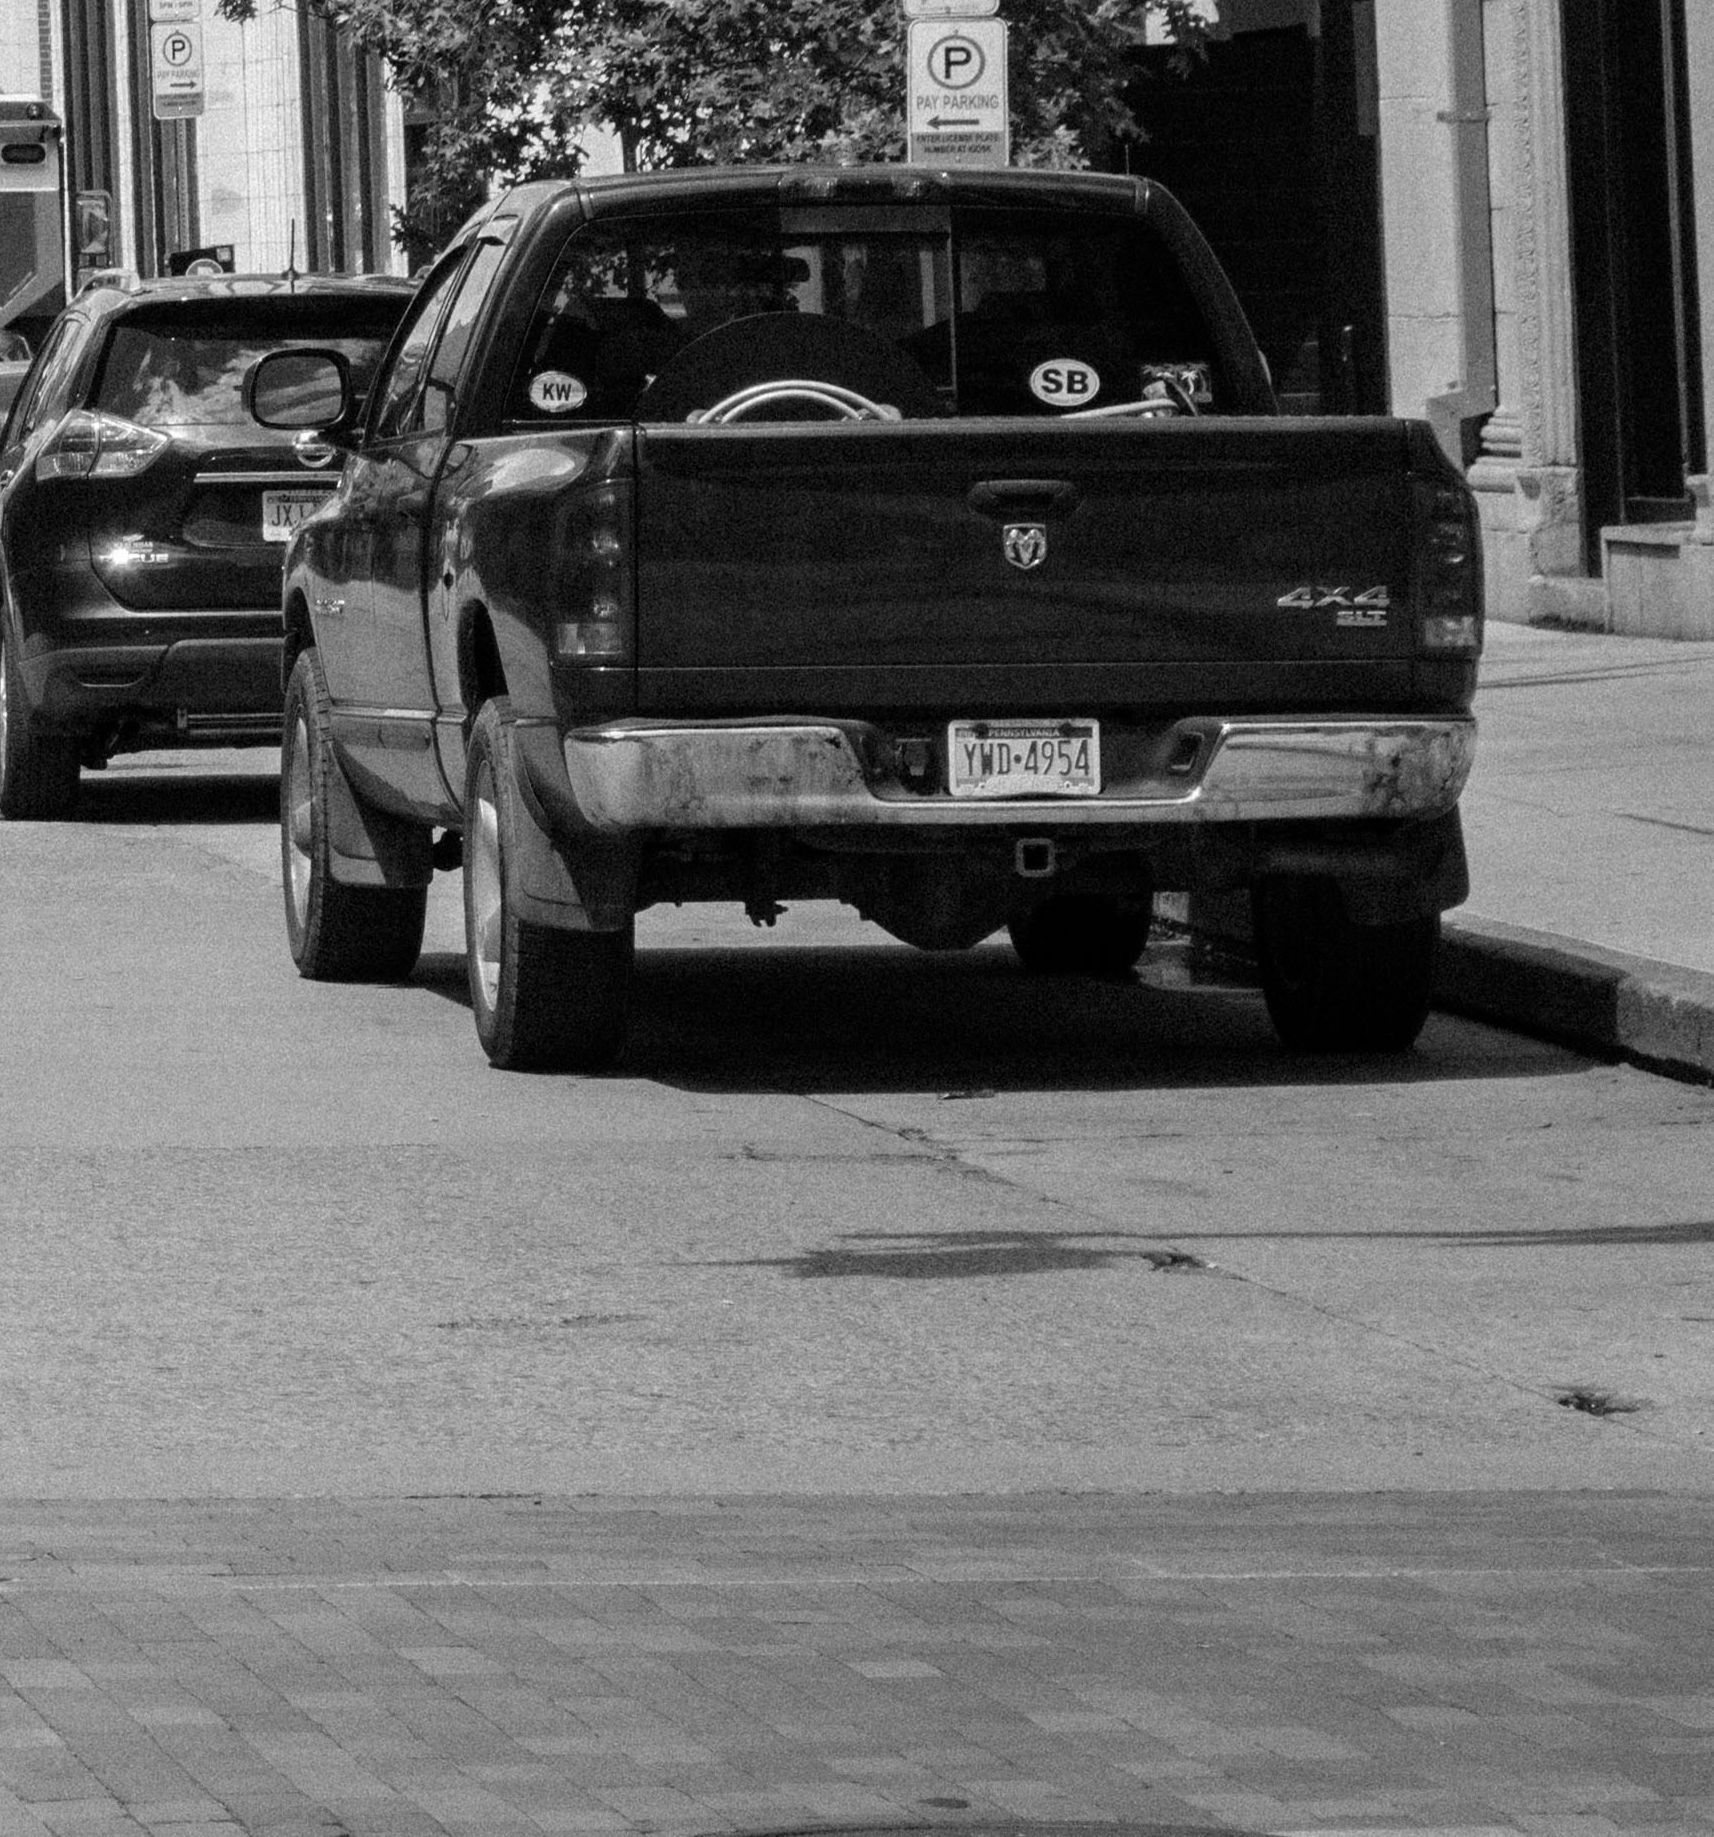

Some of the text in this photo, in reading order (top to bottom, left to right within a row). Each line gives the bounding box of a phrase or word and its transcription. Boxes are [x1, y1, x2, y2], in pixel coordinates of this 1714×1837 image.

[171, 39, 186, 60] P
[944, 46, 971, 79] P
[916, 94, 999, 110] PAY PARKING
[1040, 368, 1089, 395] SB
[542, 383, 572, 402] KW
[987, 728, 1061, 738] PENNSYLVANIA
